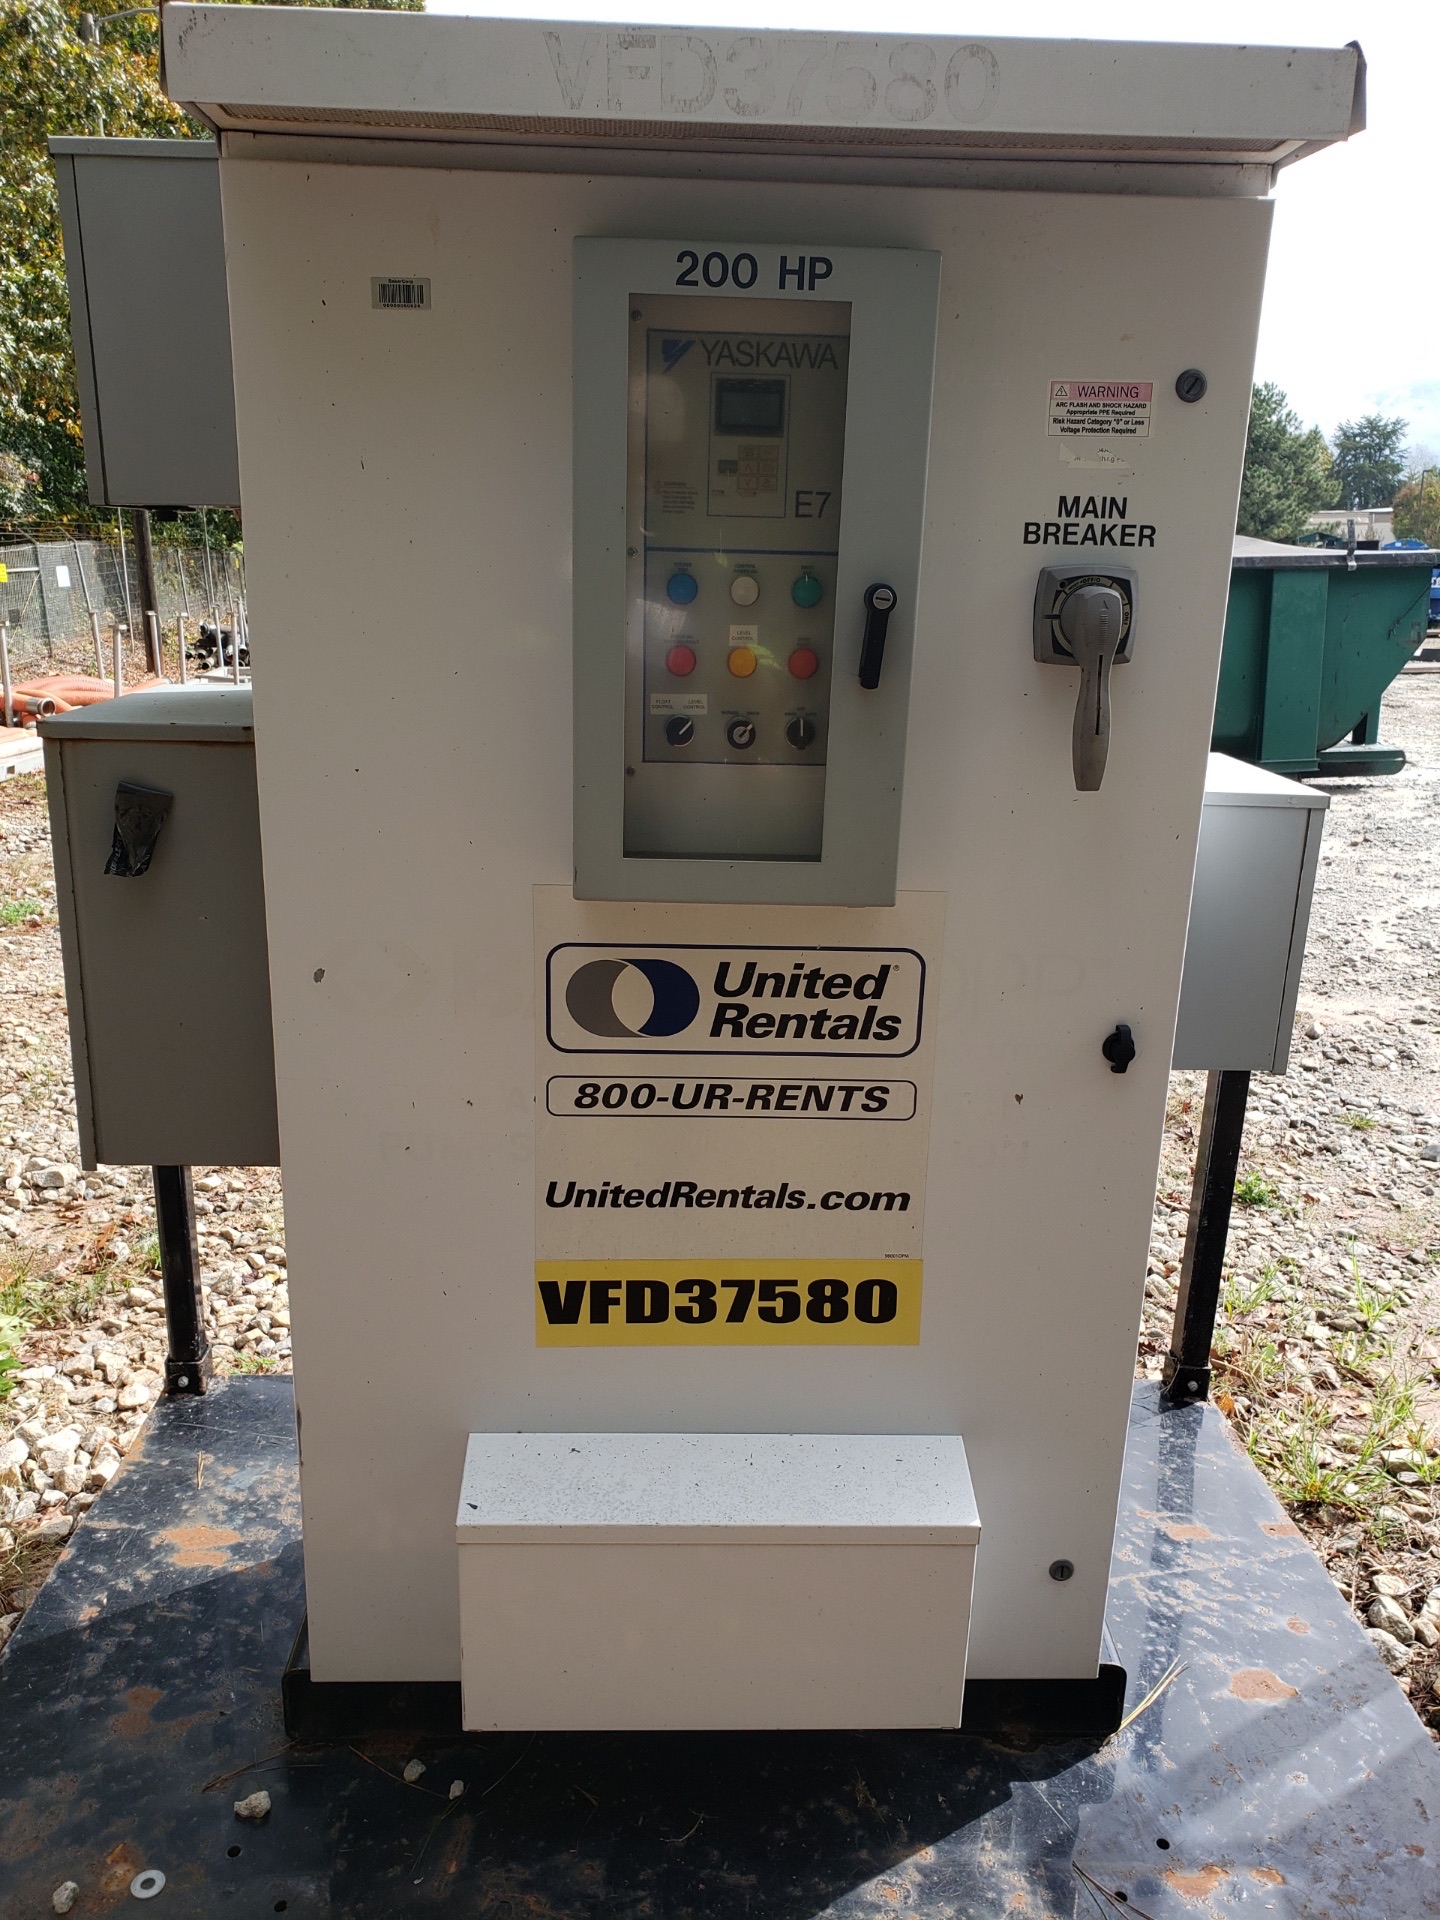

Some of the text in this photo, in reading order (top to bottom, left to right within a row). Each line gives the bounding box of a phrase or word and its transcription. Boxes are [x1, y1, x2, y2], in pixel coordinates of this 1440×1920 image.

[675, 250, 834, 291] 200 HP
[700, 339, 840, 370] YASKAWA
[1077, 385, 1139, 399] WARNING
[1059, 427, 1081, 435] Voltage
[1087, 418, 1113, 427] Category
[794, 490, 832, 519] E7
[1057, 495, 1128, 520] MAIN
[1022, 522, 1157, 548] BREAKER
[712, 960, 893, 1001] United
[709, 1002, 903, 1041] Rentals
[574, 1083, 890, 1113] 800-UR-RENTS
[545, 1181, 912, 1212] UnitedRentals.com
[537, 1278, 898, 1325] VFD37580
